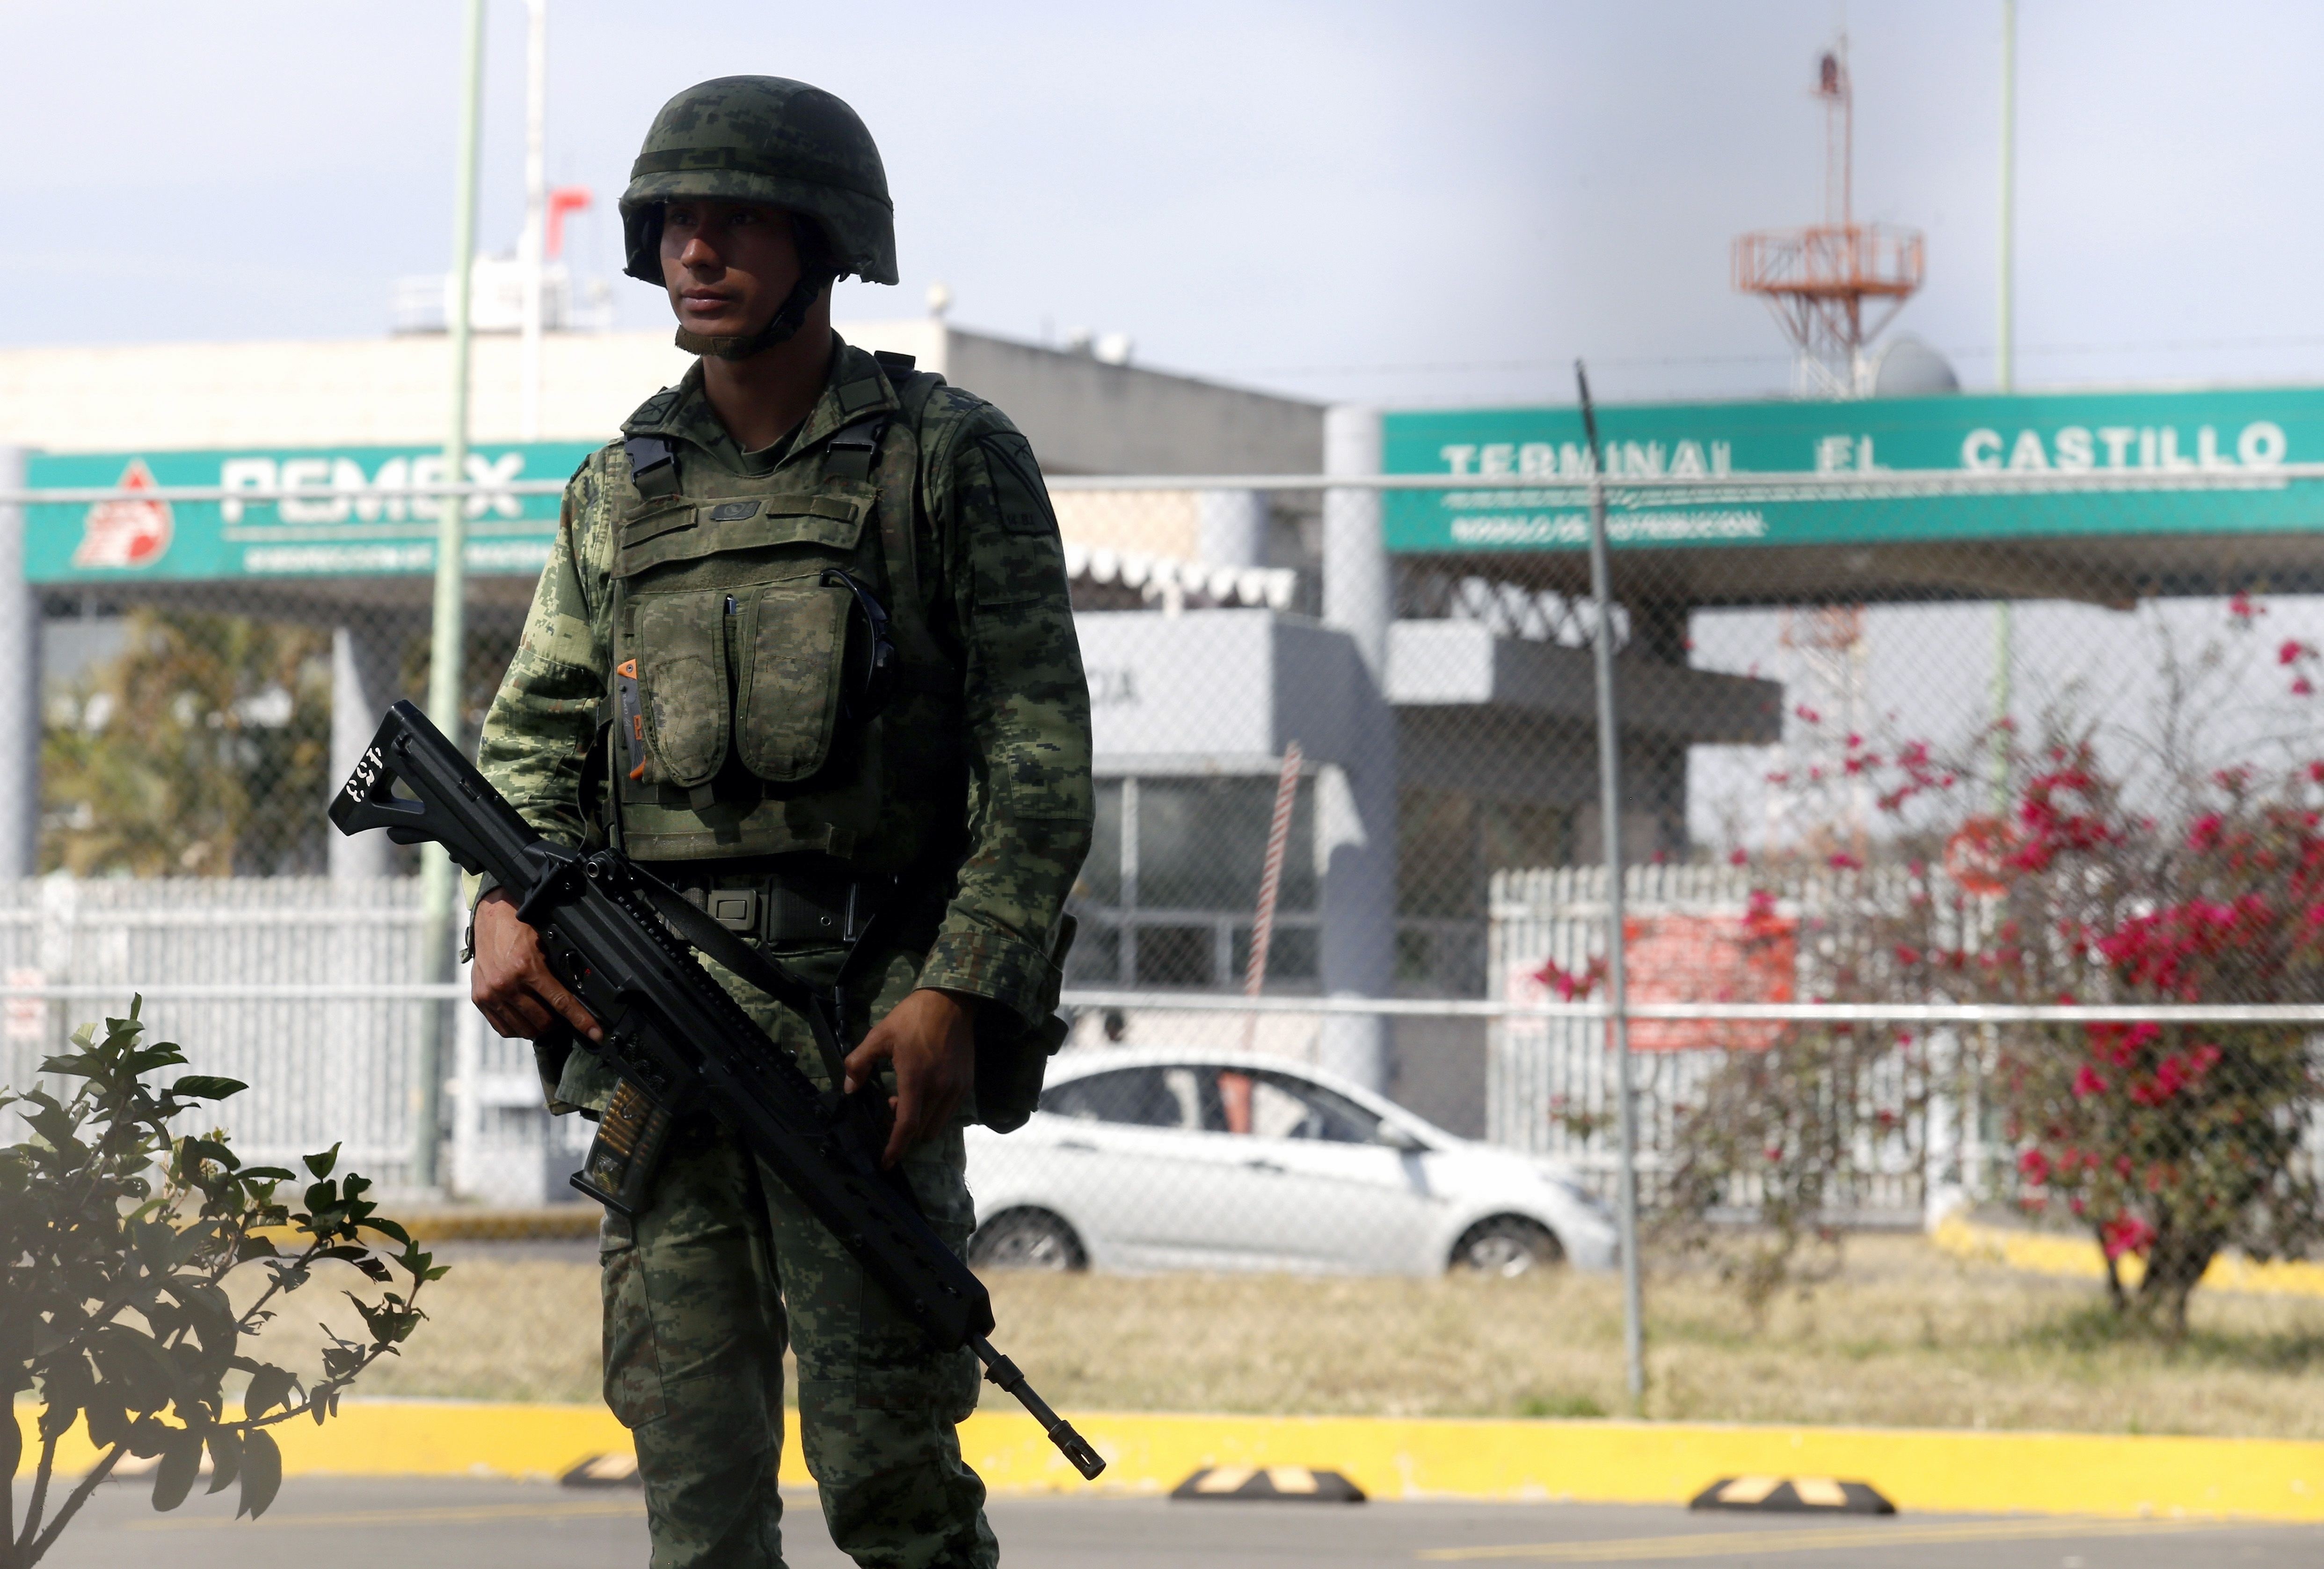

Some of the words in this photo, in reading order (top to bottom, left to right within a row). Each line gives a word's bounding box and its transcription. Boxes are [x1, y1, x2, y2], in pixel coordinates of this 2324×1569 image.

[1441, 441, 1732, 479] TERMINAL
[1961, 420, 2288, 474] CASTILLO
[220, 452, 525, 523] PEMEX
[345, 747, 384, 803] 453
